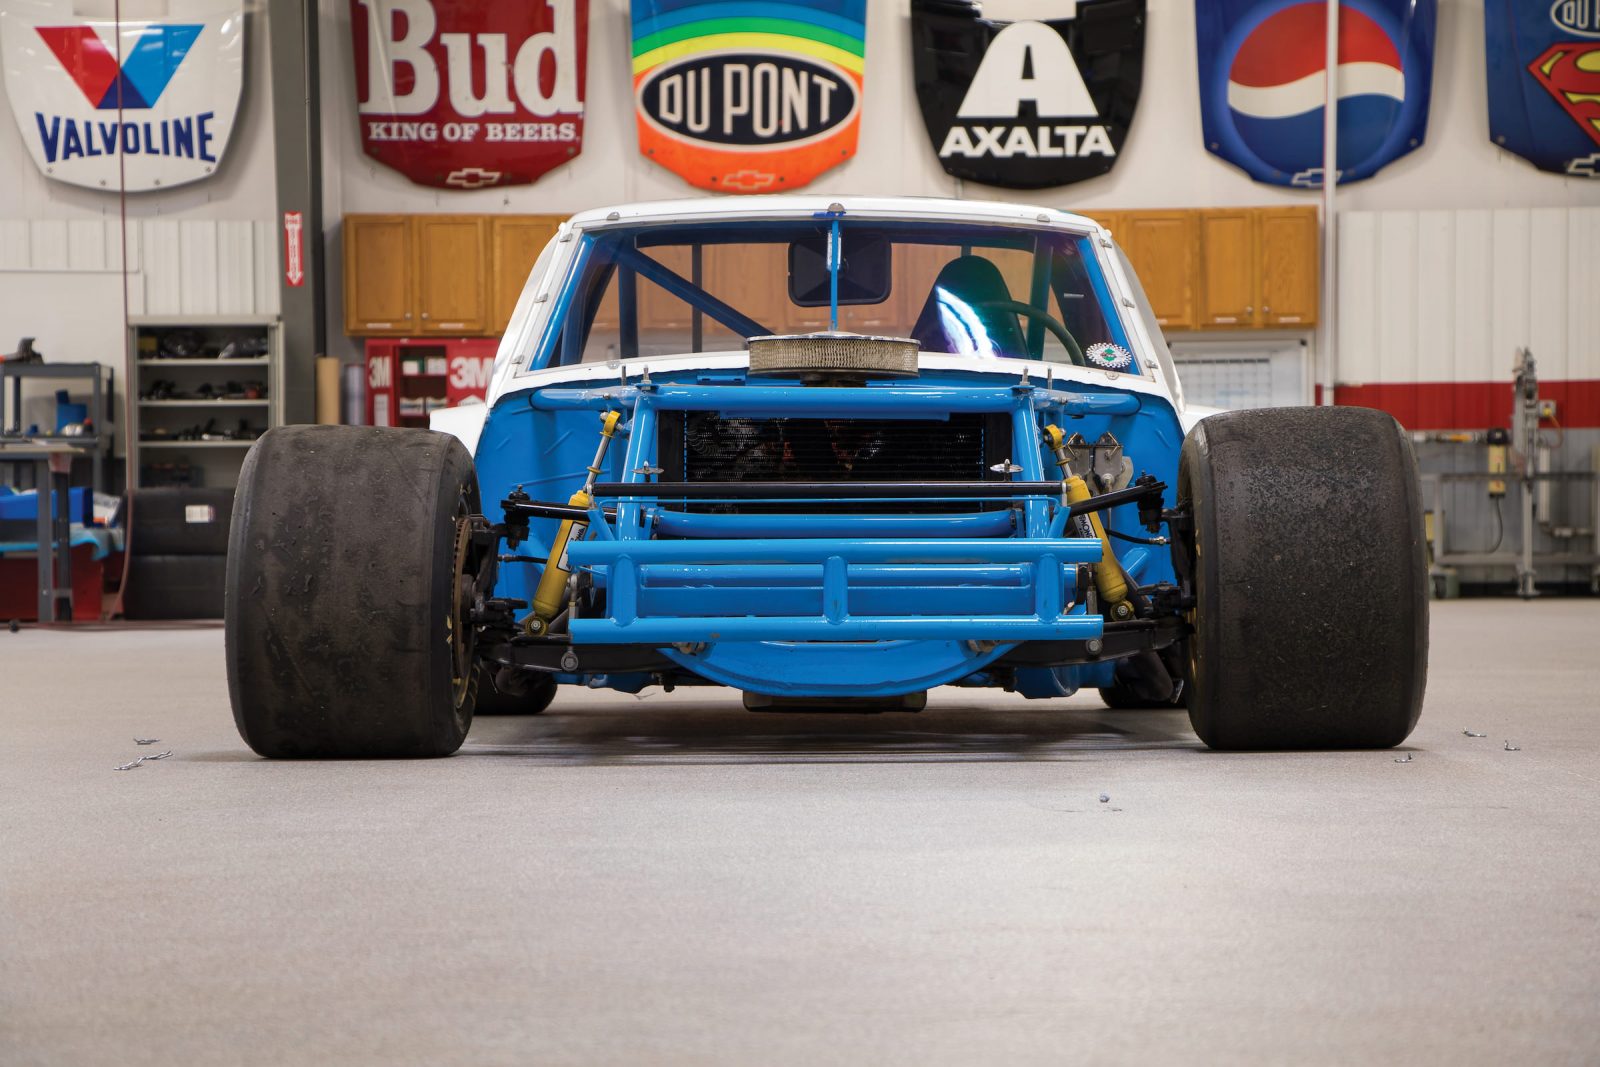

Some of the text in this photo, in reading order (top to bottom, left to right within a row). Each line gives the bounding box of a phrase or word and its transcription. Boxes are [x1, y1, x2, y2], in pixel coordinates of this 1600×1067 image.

[359, 0, 584, 118] Bud
[659, 62, 838, 138] DU PONT
[35, 111, 216, 163] VALVOLINE
[368, 121, 576, 142] KING OF BEERS
[938, 125, 1117, 158] AXALTA
[368, 356, 392, 389] 3M
[450, 356, 495, 390] 3M
